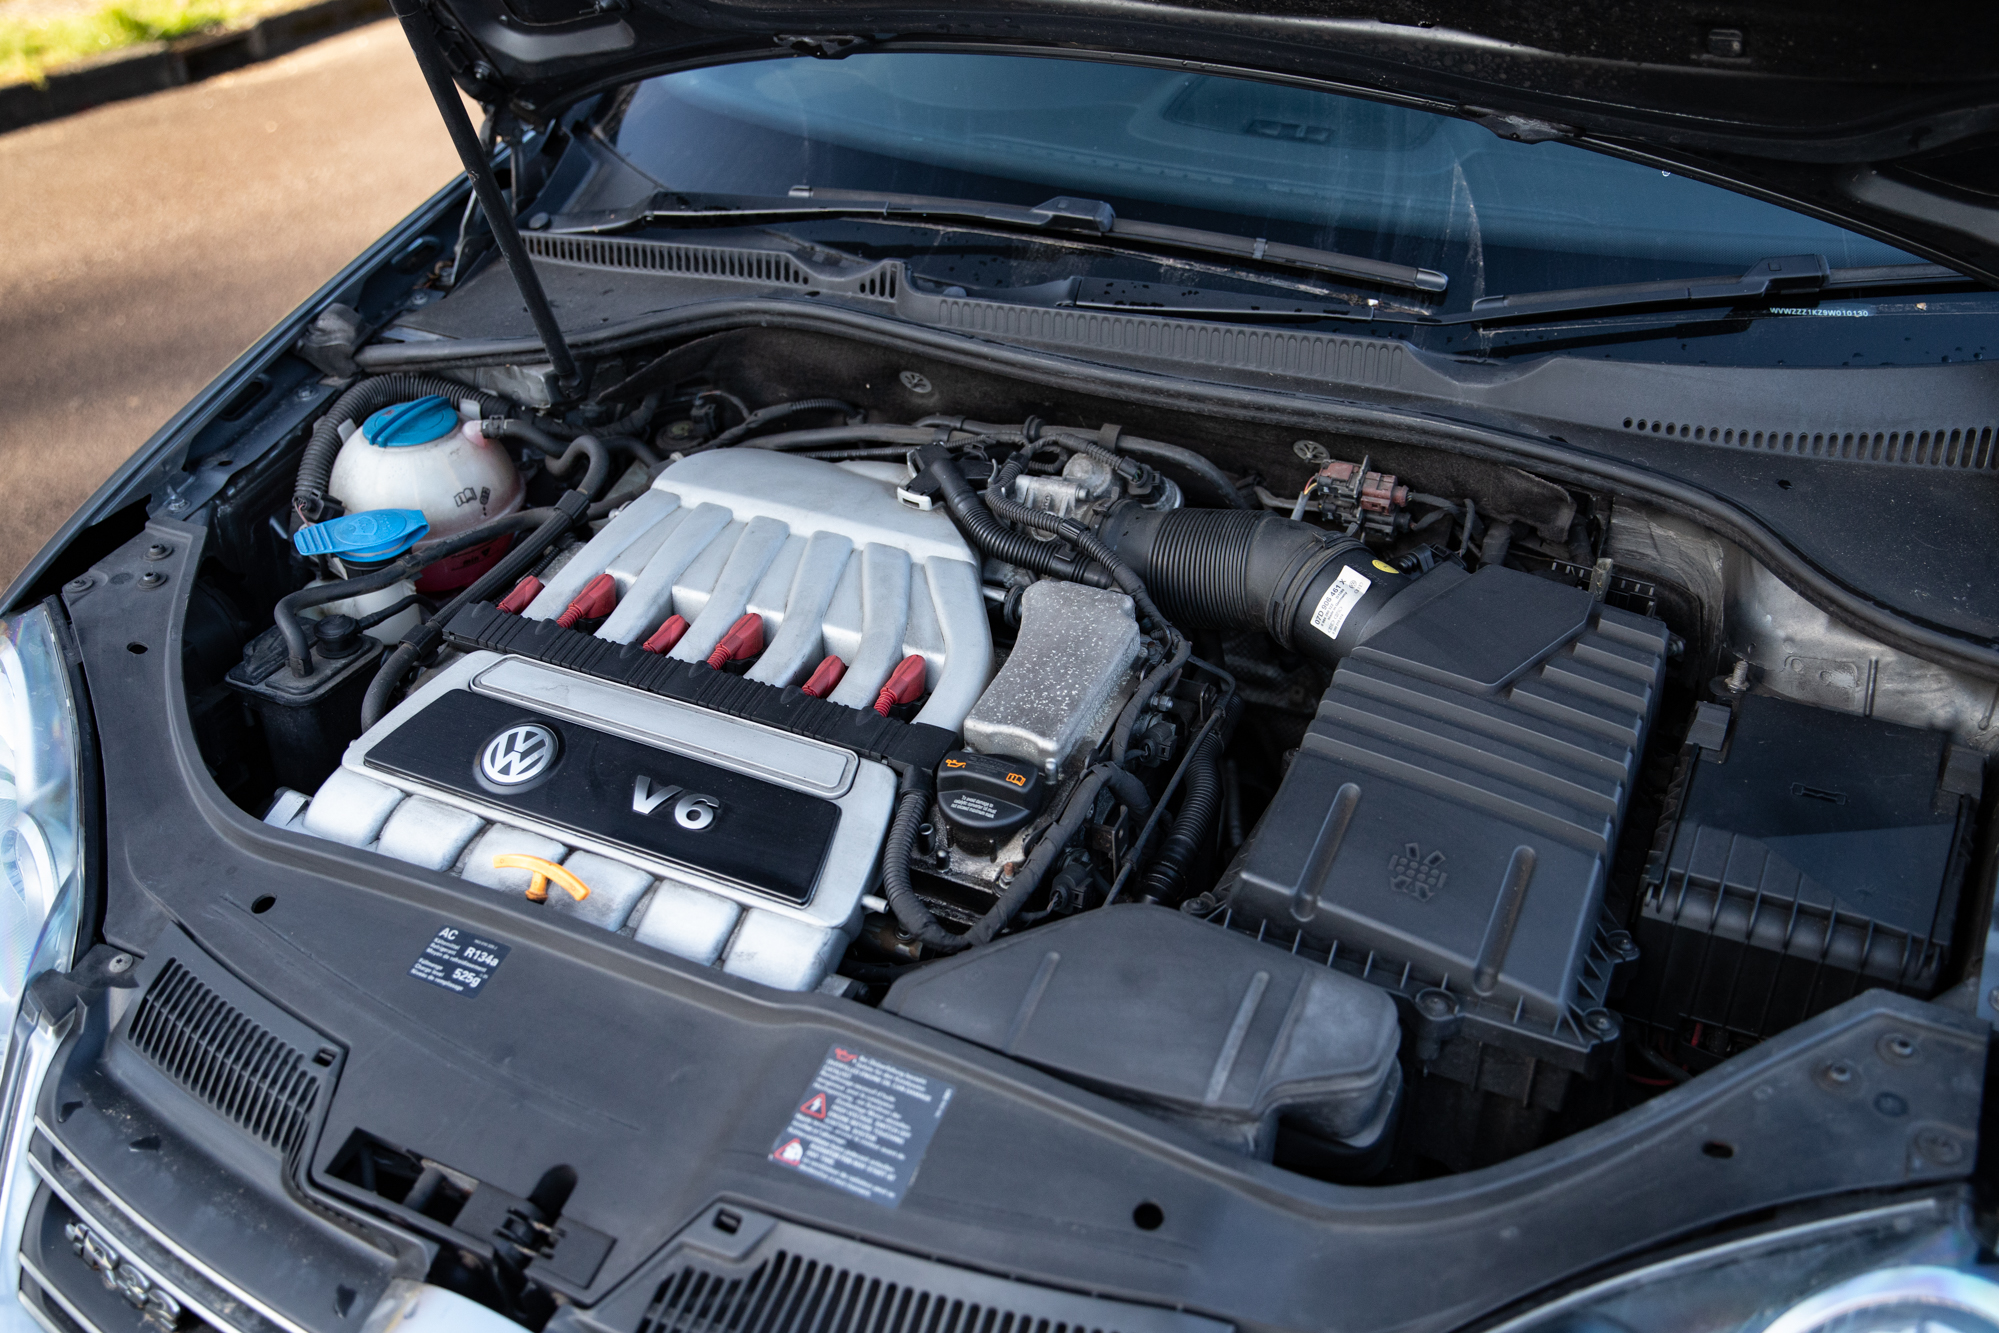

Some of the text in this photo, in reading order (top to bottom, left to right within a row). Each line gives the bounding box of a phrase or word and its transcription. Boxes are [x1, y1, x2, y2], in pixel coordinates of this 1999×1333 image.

[1330, 584, 1341, 597] 461
[633, 775, 720, 830] V6
[438, 927, 459, 940] AC
[463, 946, 499, 967] R134a
[452, 967, 481, 988] 525g
